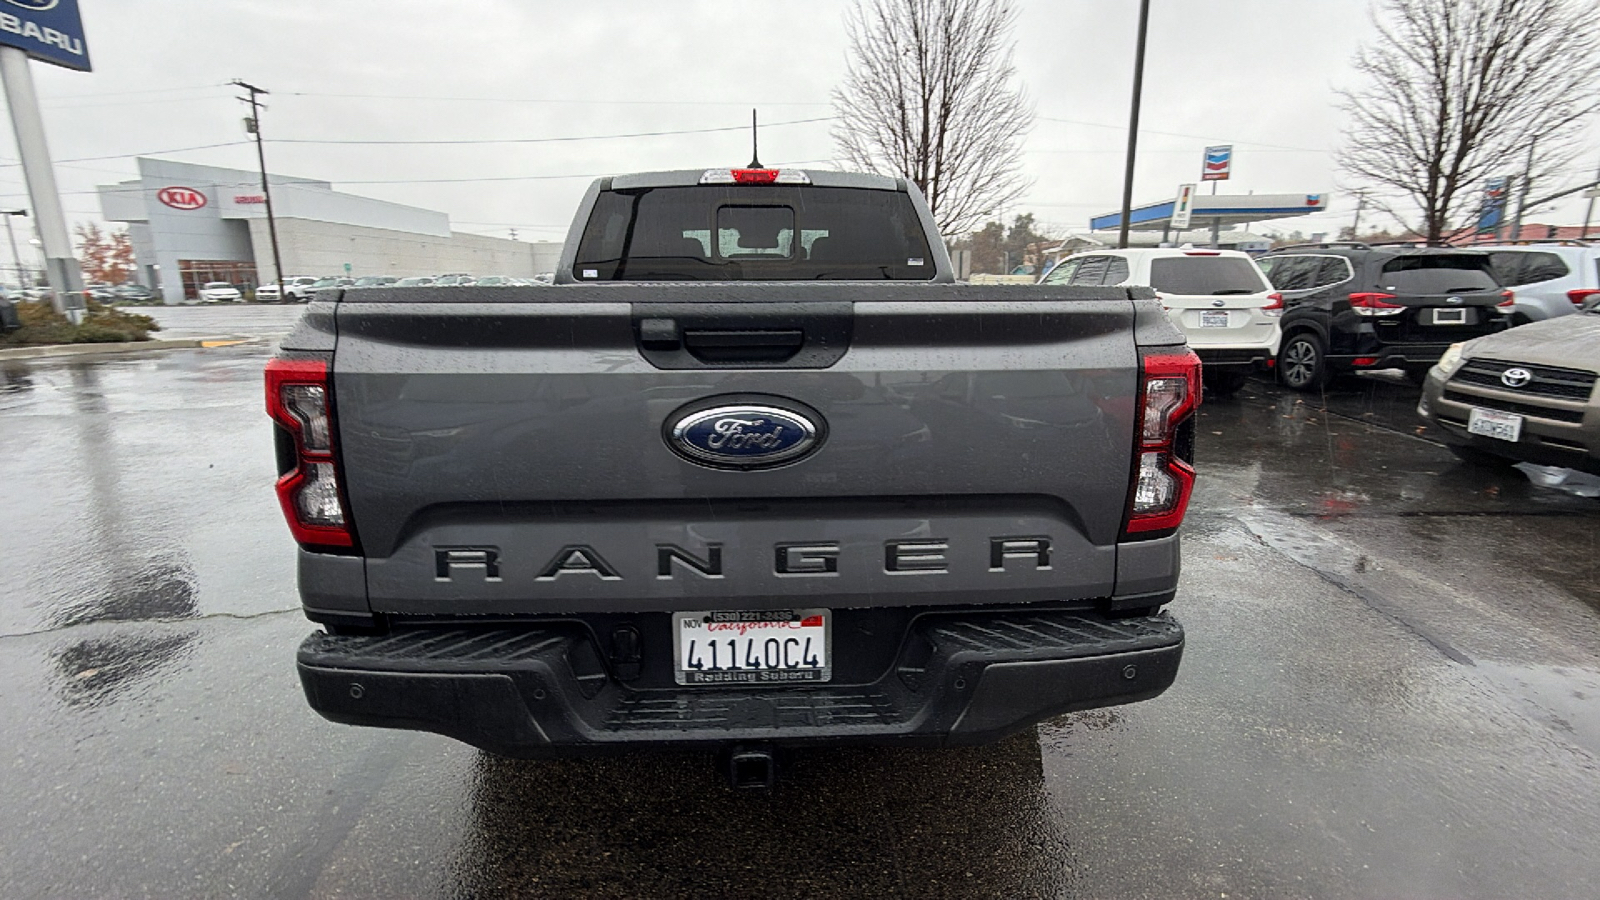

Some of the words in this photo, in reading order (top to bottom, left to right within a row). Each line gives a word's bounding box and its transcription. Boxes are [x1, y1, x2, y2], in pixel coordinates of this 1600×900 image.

[167, 191, 199, 206] KIA
[708, 418, 782, 448] Ford
[434, 535, 1054, 582] RANGER
[683, 619, 703, 629] NOV
[713, 611, 740, 622] (530)
[687, 637, 819, 671] 41140C4
[694, 672, 756, 682] Redding
[760, 670, 814, 680] Subaru
